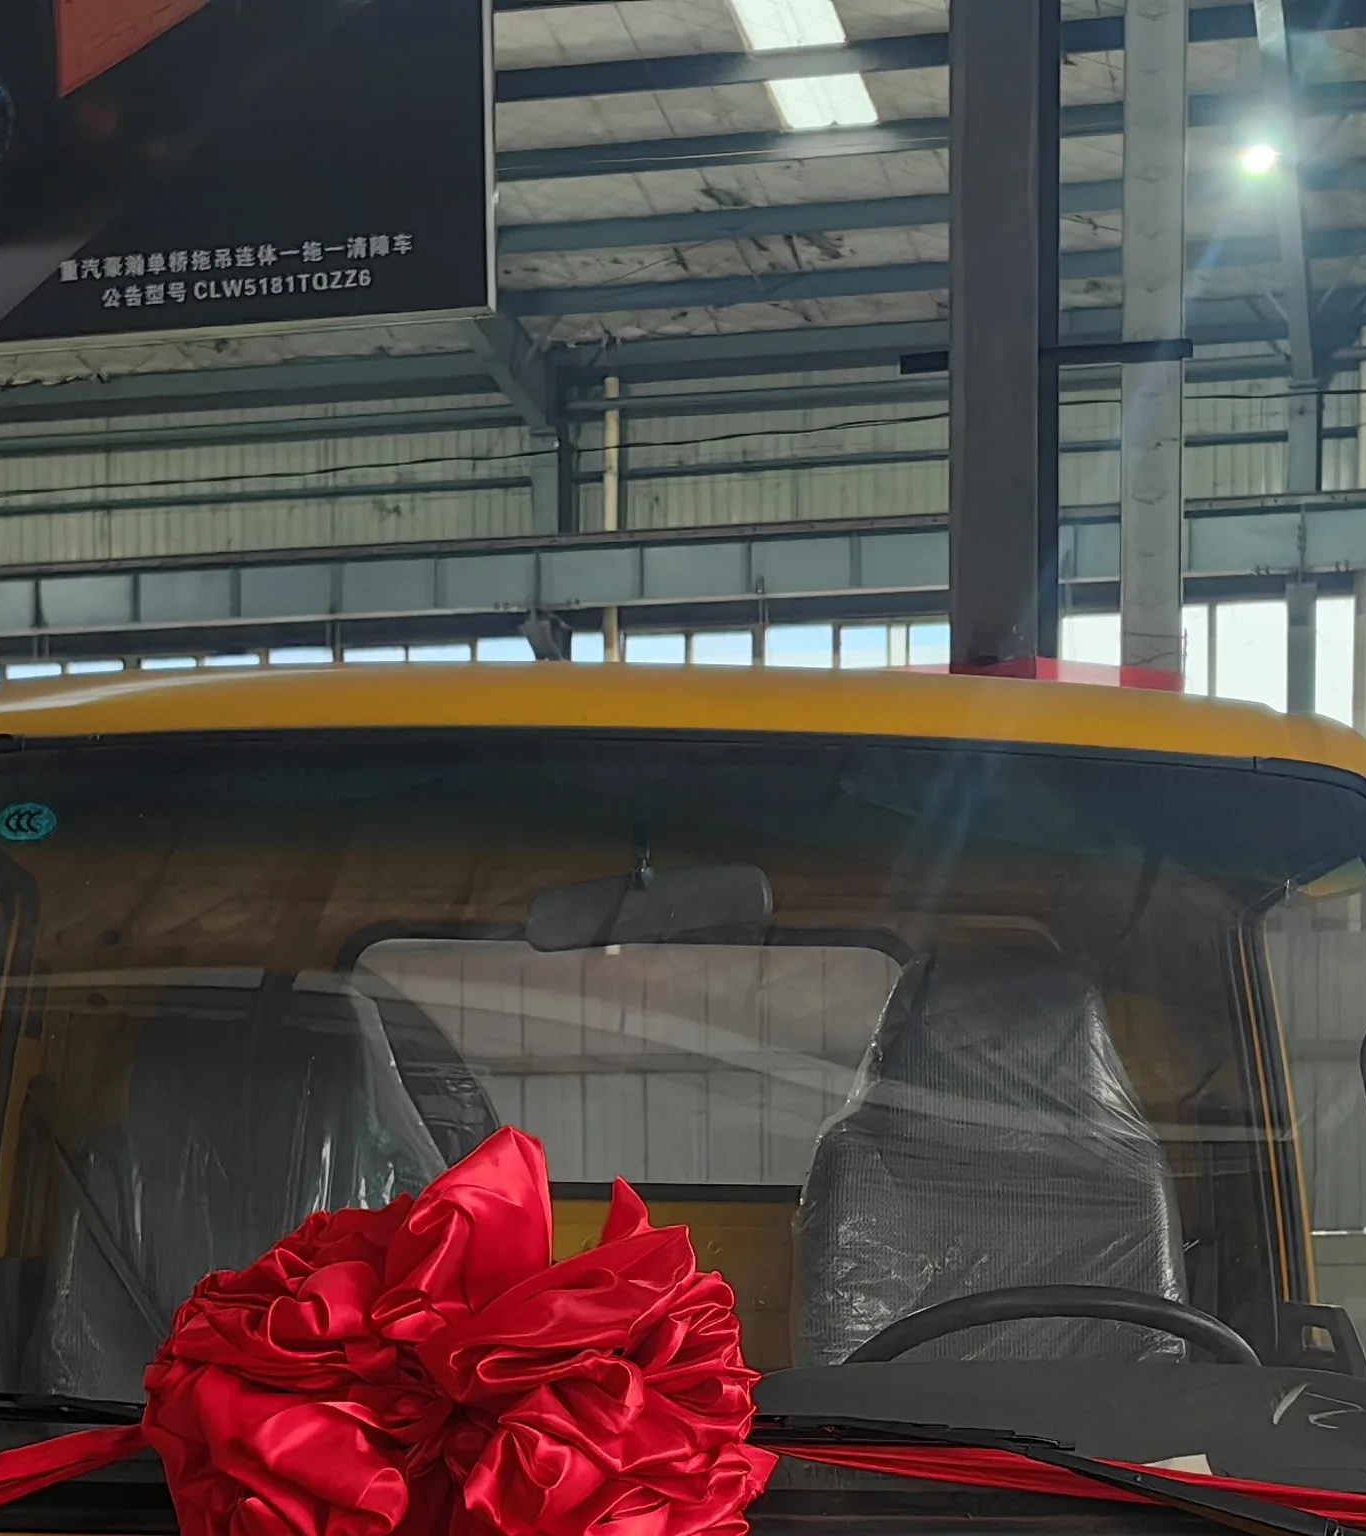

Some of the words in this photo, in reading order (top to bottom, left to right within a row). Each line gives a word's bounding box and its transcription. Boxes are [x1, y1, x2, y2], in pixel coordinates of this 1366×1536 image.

[102, 281, 187, 309] 公告型号
[193, 269, 373, 301] CLW5181TQZZ6
